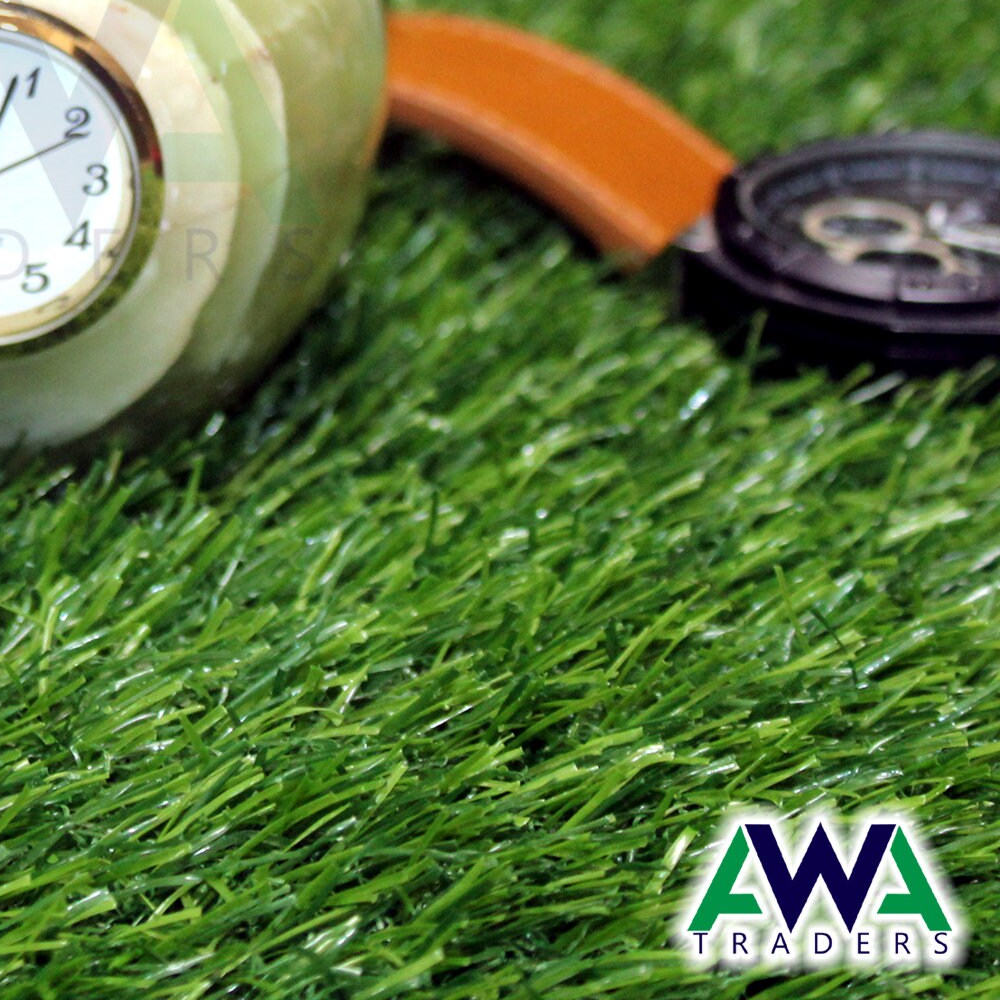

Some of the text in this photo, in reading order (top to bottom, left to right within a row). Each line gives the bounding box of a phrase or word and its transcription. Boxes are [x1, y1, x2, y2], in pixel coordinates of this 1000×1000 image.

[25, 67, 41, 99] 1
[63, 106, 92, 139] 2
[82, 163, 109, 197] 3
[63, 220, 92, 251] 4
[20, 262, 51, 293] 5
